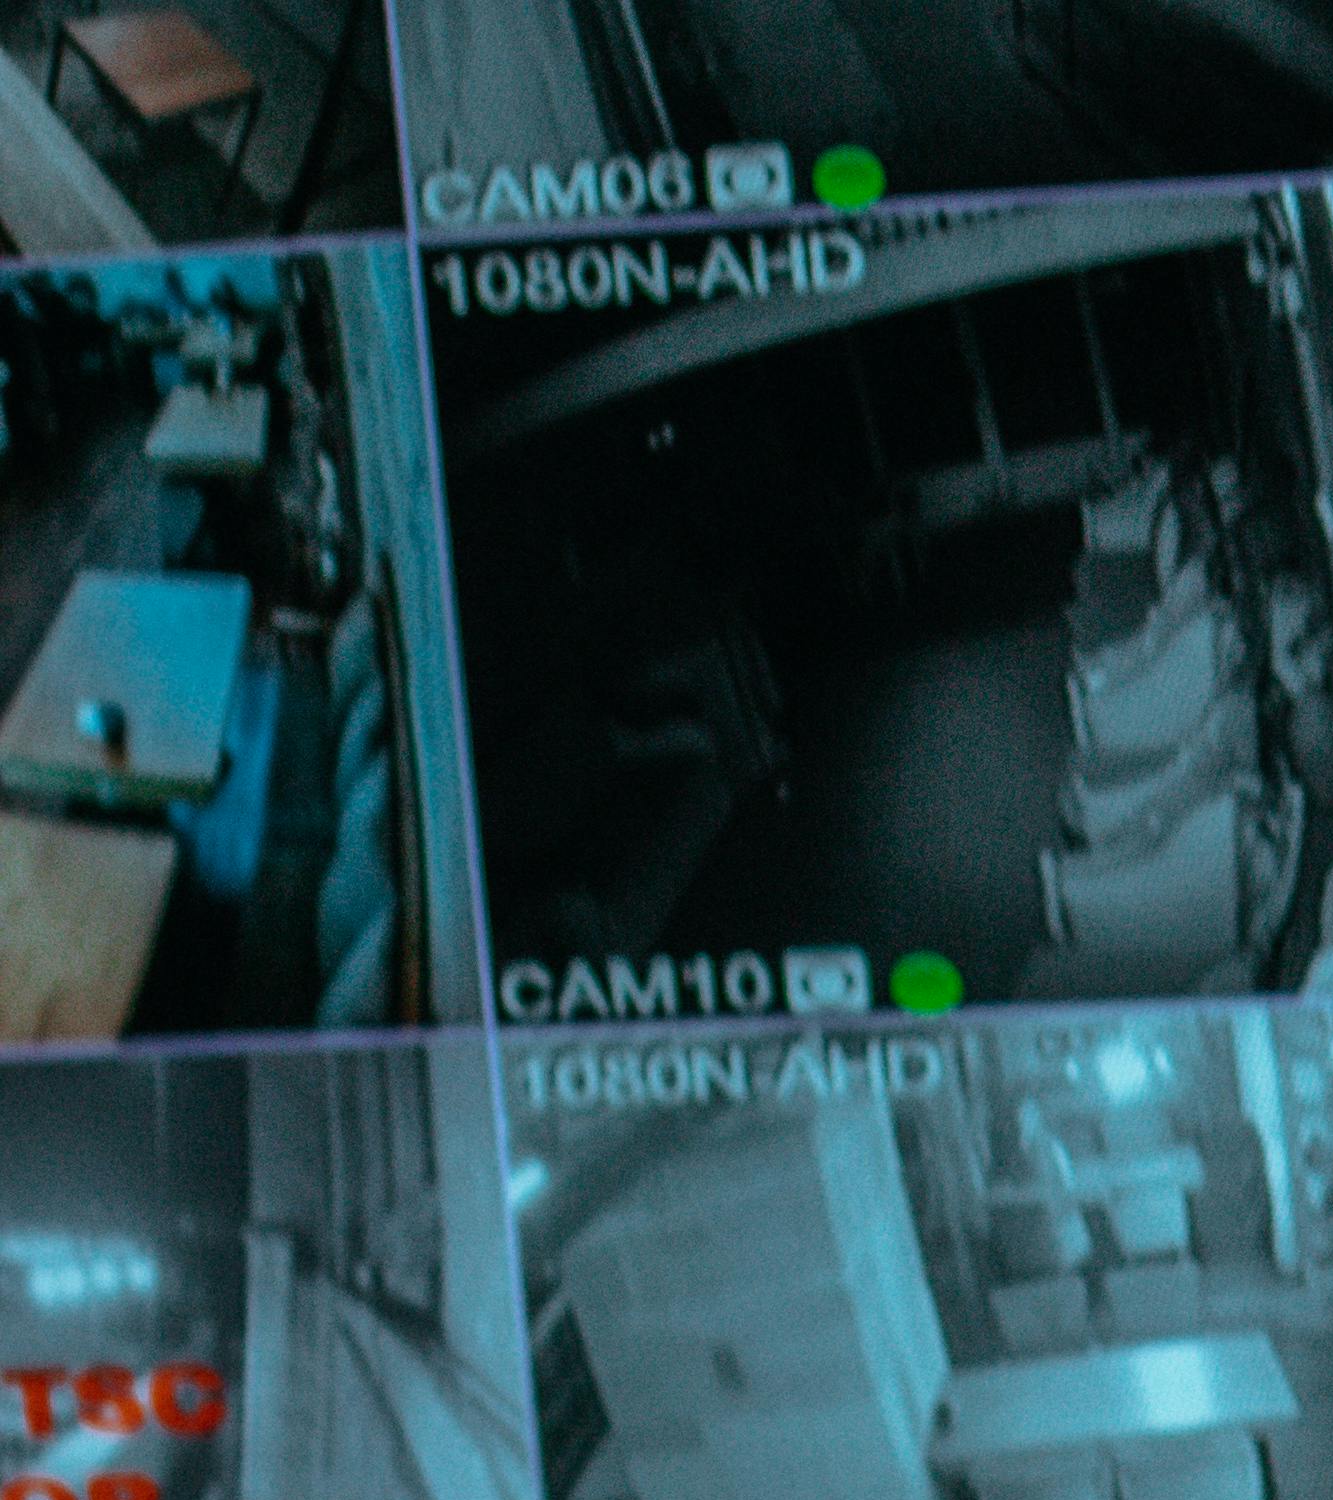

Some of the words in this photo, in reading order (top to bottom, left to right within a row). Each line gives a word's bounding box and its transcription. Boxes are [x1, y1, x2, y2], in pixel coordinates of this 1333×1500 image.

[421, 148, 694, 226] CAM06
[434, 229, 866, 316] 1080N-AHD
[501, 949, 774, 1021] CAM10
